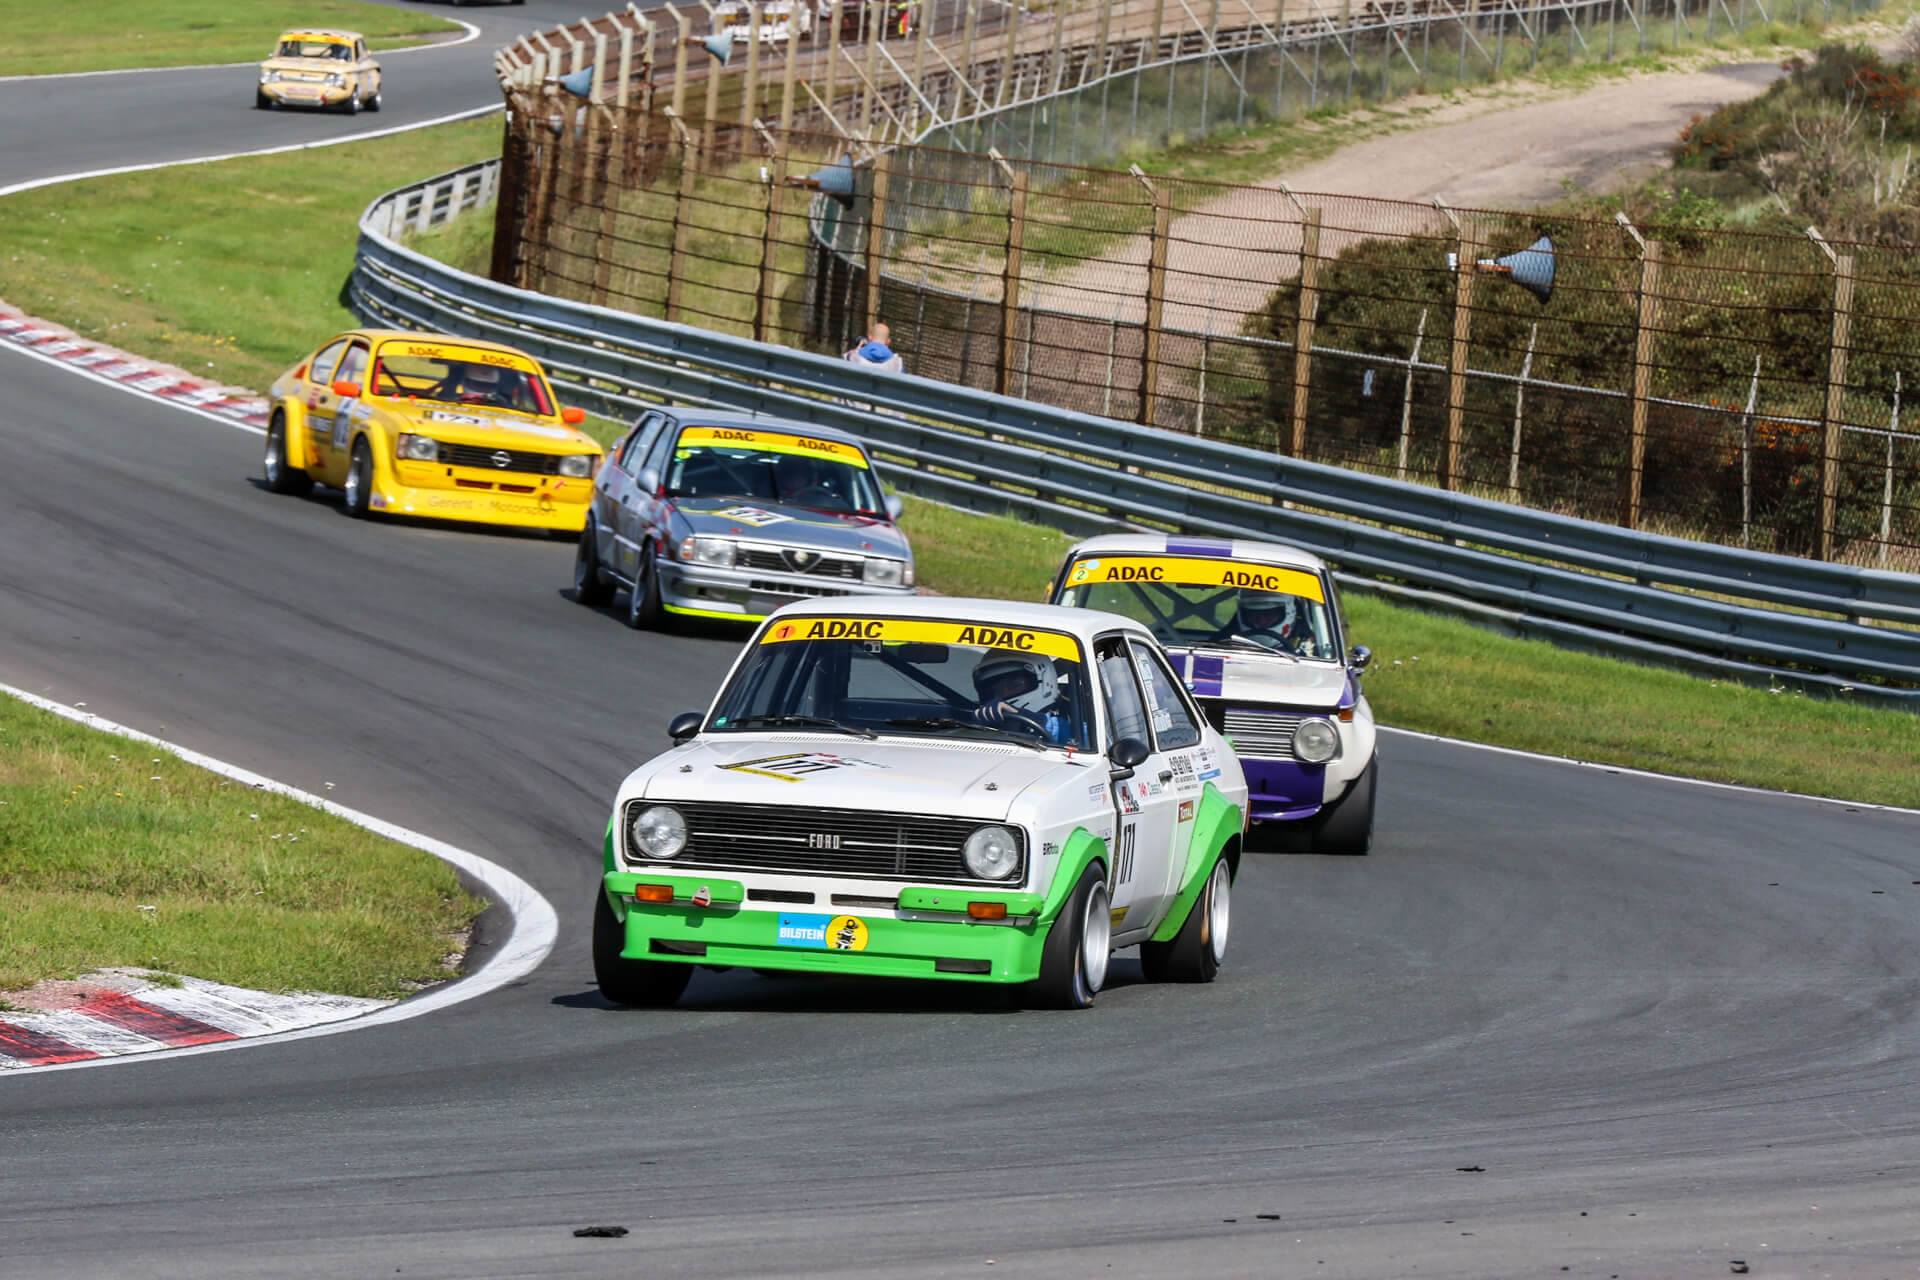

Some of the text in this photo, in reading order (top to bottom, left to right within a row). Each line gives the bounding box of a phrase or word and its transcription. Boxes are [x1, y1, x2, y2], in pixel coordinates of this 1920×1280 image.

[407, 346, 444, 358] ADAC
[480, 354, 516, 368] ADAC
[711, 430, 756, 442] ADAC
[797, 439, 840, 454] ADAC
[1076, 569, 1086, 581] 2
[1106, 566, 1164, 581] ADAC
[1221, 570, 1279, 590] ADAC
[806, 621, 884, 639] ADAC
[957, 626, 1035, 650] ADAC
[809, 833, 840, 849] FORD
[779, 927, 825, 941] BILSTEIN
